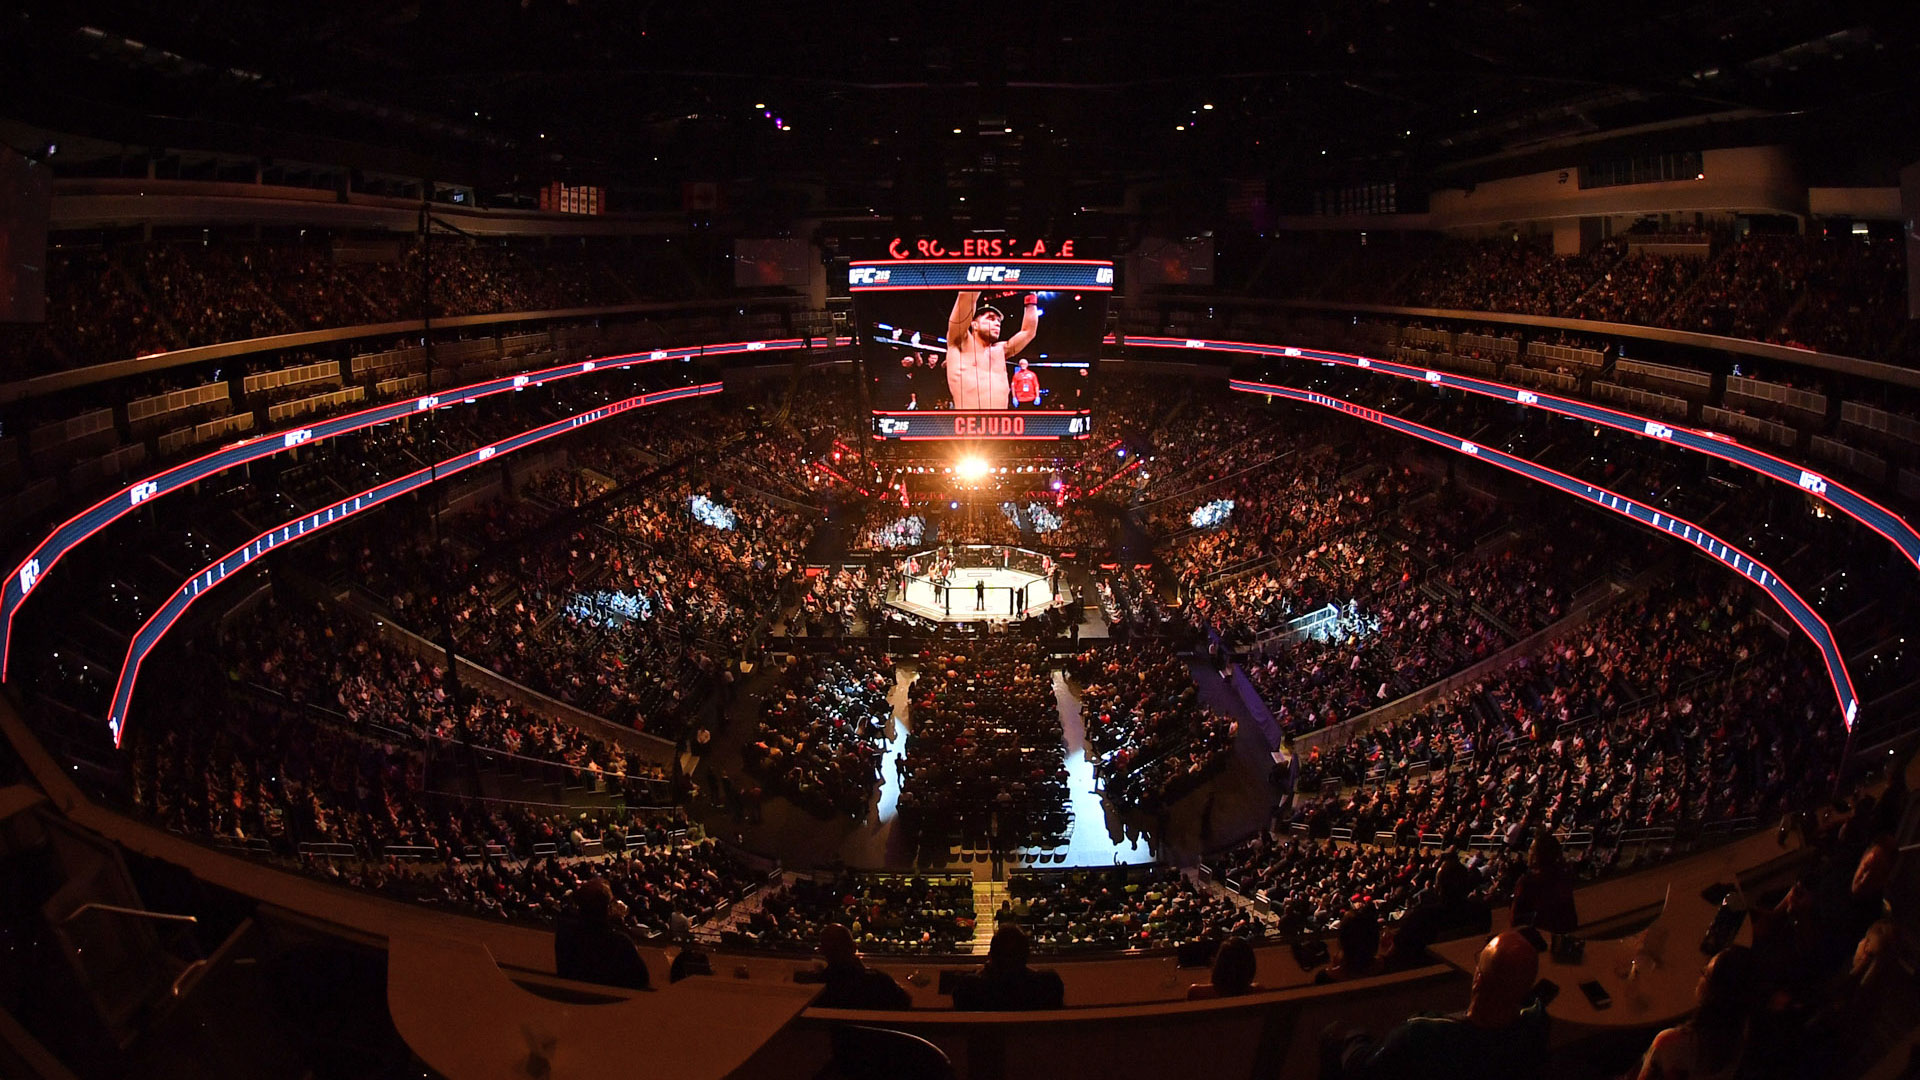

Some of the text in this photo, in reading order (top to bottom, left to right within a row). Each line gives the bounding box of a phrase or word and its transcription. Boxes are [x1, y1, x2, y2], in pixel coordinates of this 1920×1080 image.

[917, 239, 1002, 257] ROERS
[966, 266, 1021, 282] UFC 215
[893, 421, 910, 431] 215
[954, 416, 1025, 436] CEJUDO
